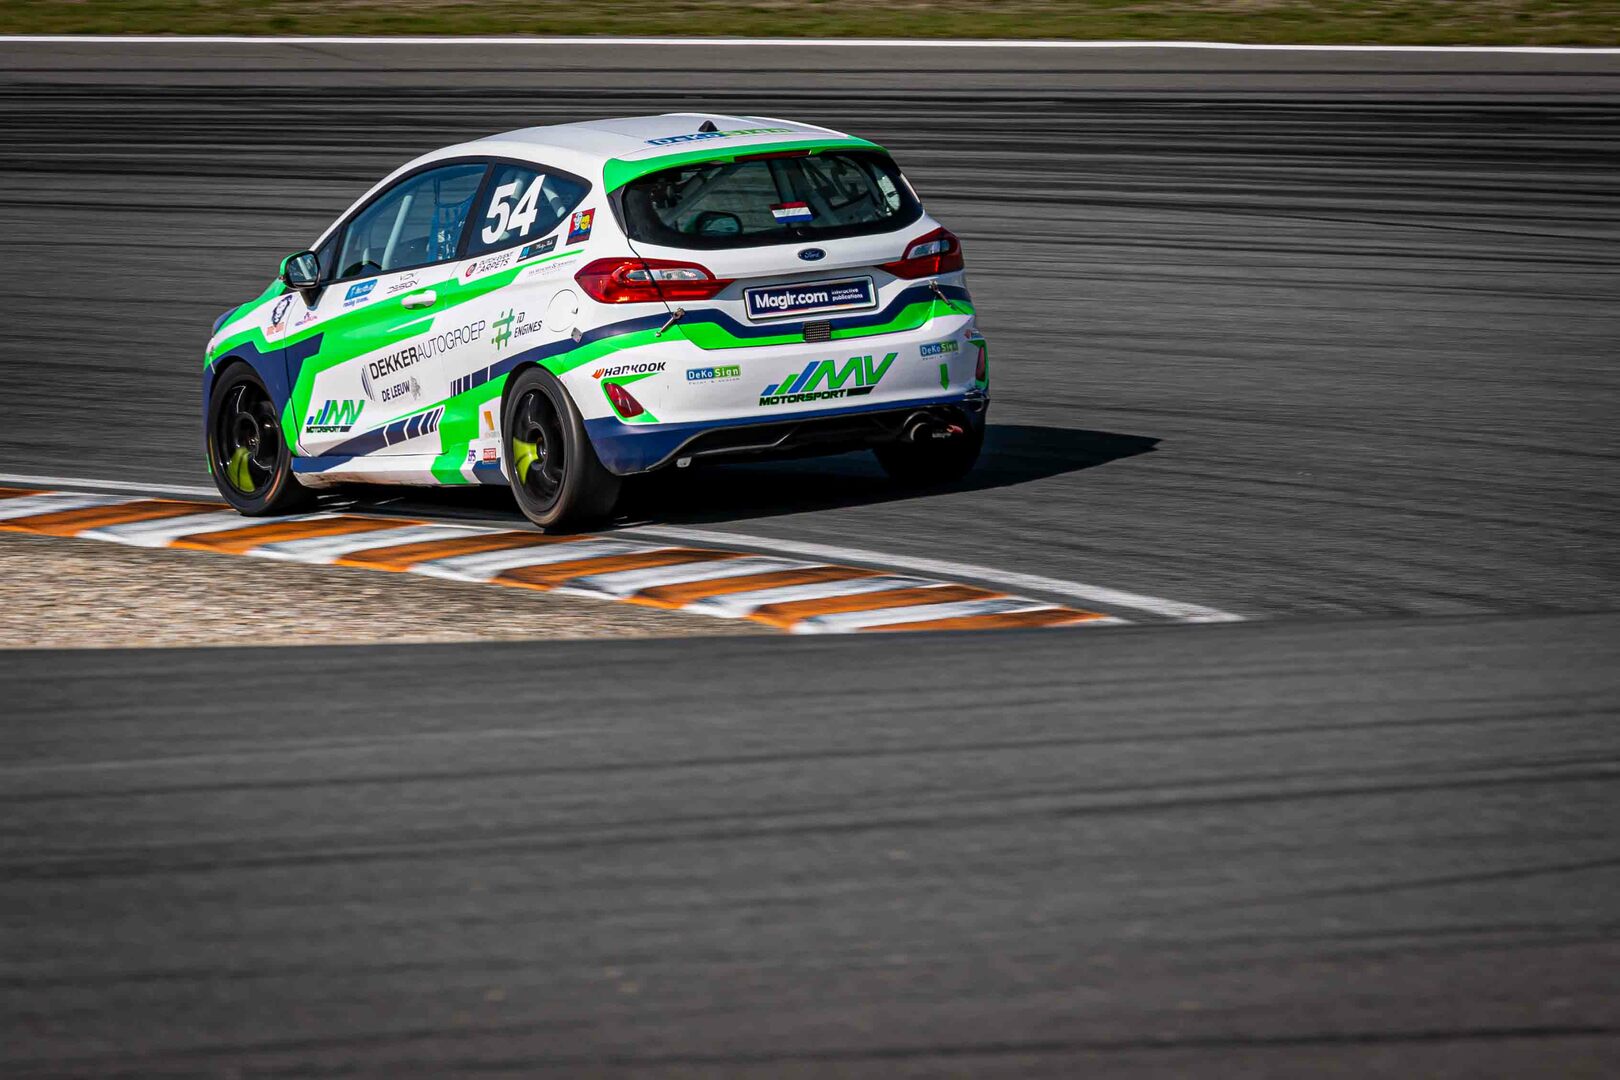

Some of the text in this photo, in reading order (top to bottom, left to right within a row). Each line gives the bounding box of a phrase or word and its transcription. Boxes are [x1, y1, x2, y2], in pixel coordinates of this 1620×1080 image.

[481, 174, 546, 244] 54
[803, 249, 821, 259] Ford
[754, 291, 829, 310] Maglr.com
[832, 293, 864, 302] publications
[514, 320, 543, 338] ENGINES
[382, 380, 410, 402] DE LEEUW
[758, 388, 848, 406] MOTORSPORT
[305, 425, 341, 433] MOTORSPORT
